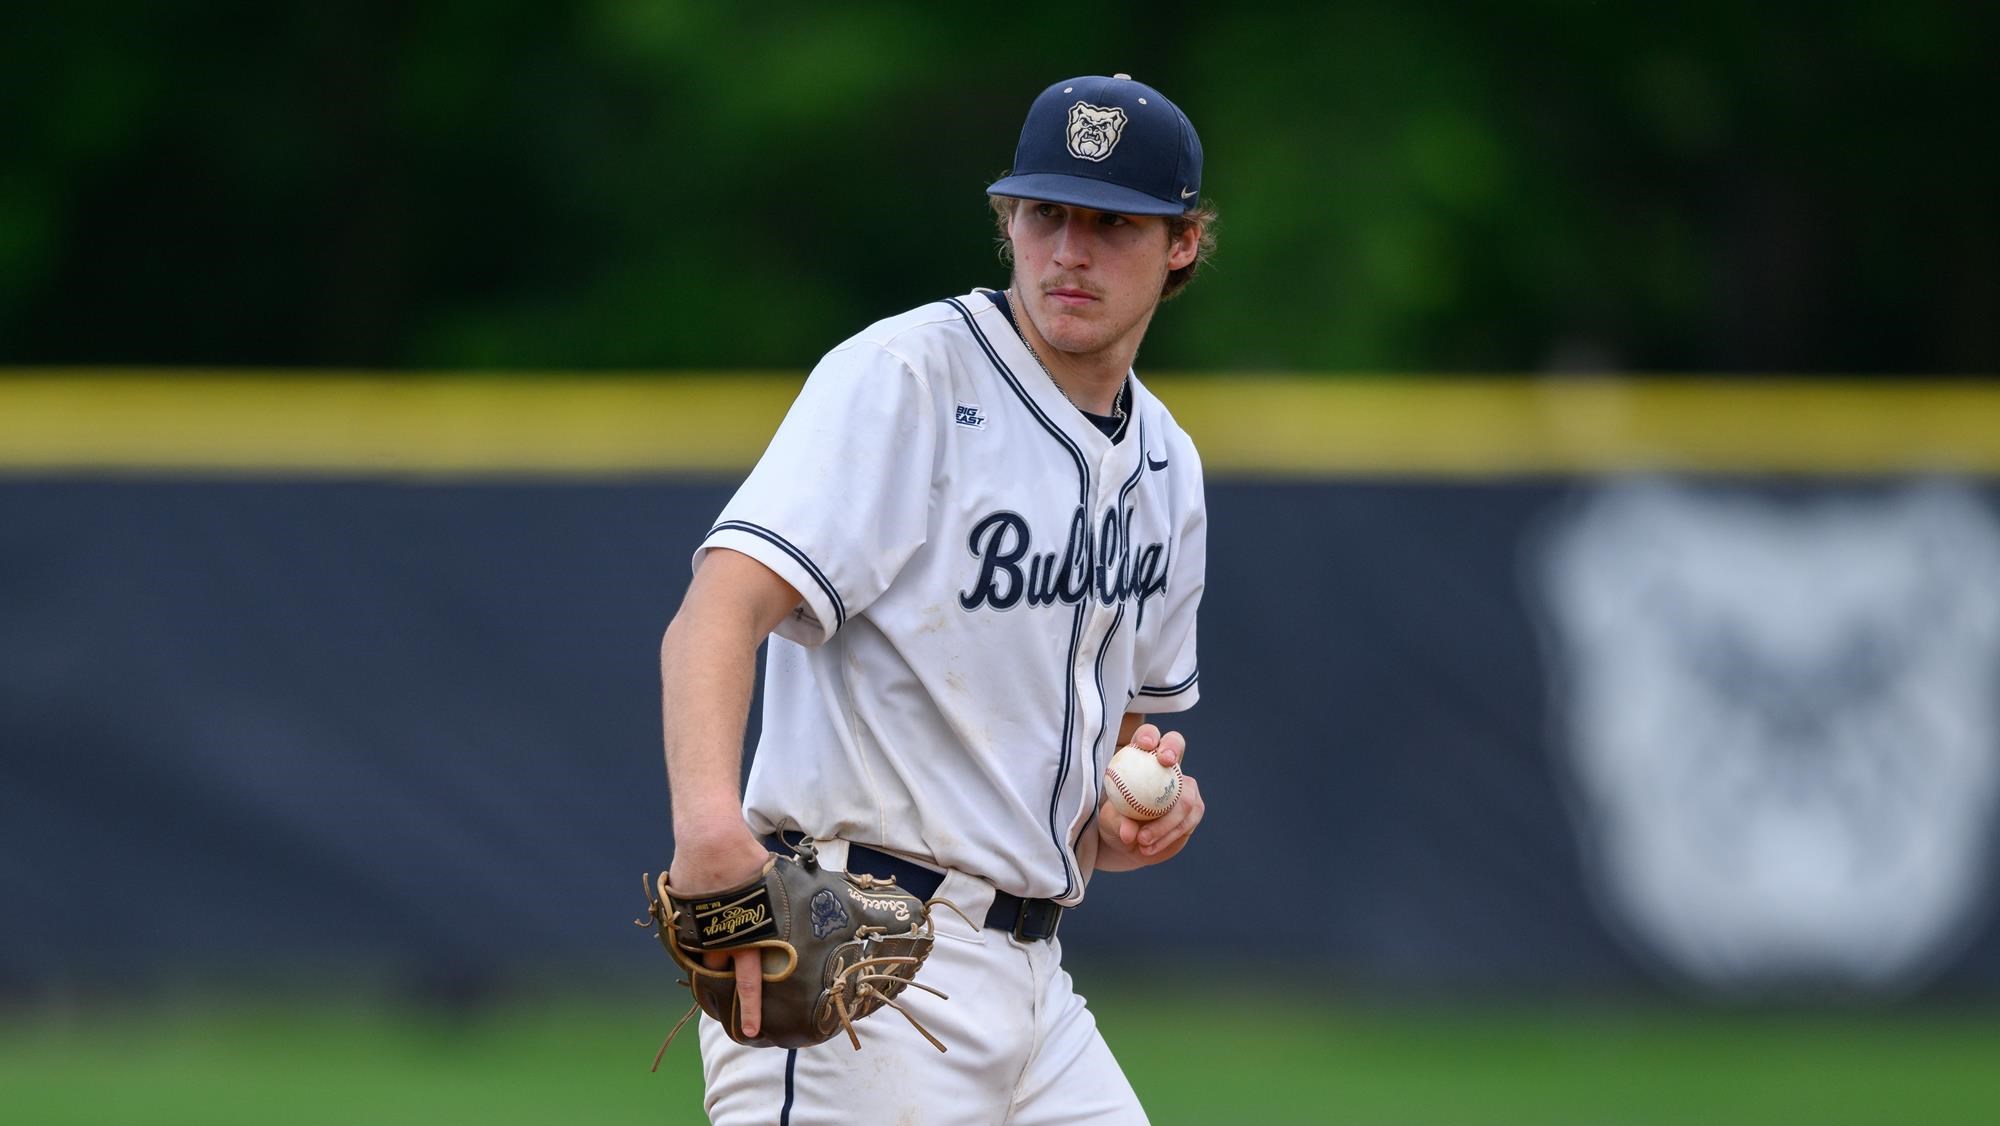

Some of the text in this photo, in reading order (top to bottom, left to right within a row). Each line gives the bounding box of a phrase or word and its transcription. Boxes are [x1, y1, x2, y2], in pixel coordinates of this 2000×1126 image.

[956, 405, 978, 416] BIG
[955, 413, 985, 425] EAST
[704, 904, 766, 935] Rawlings
